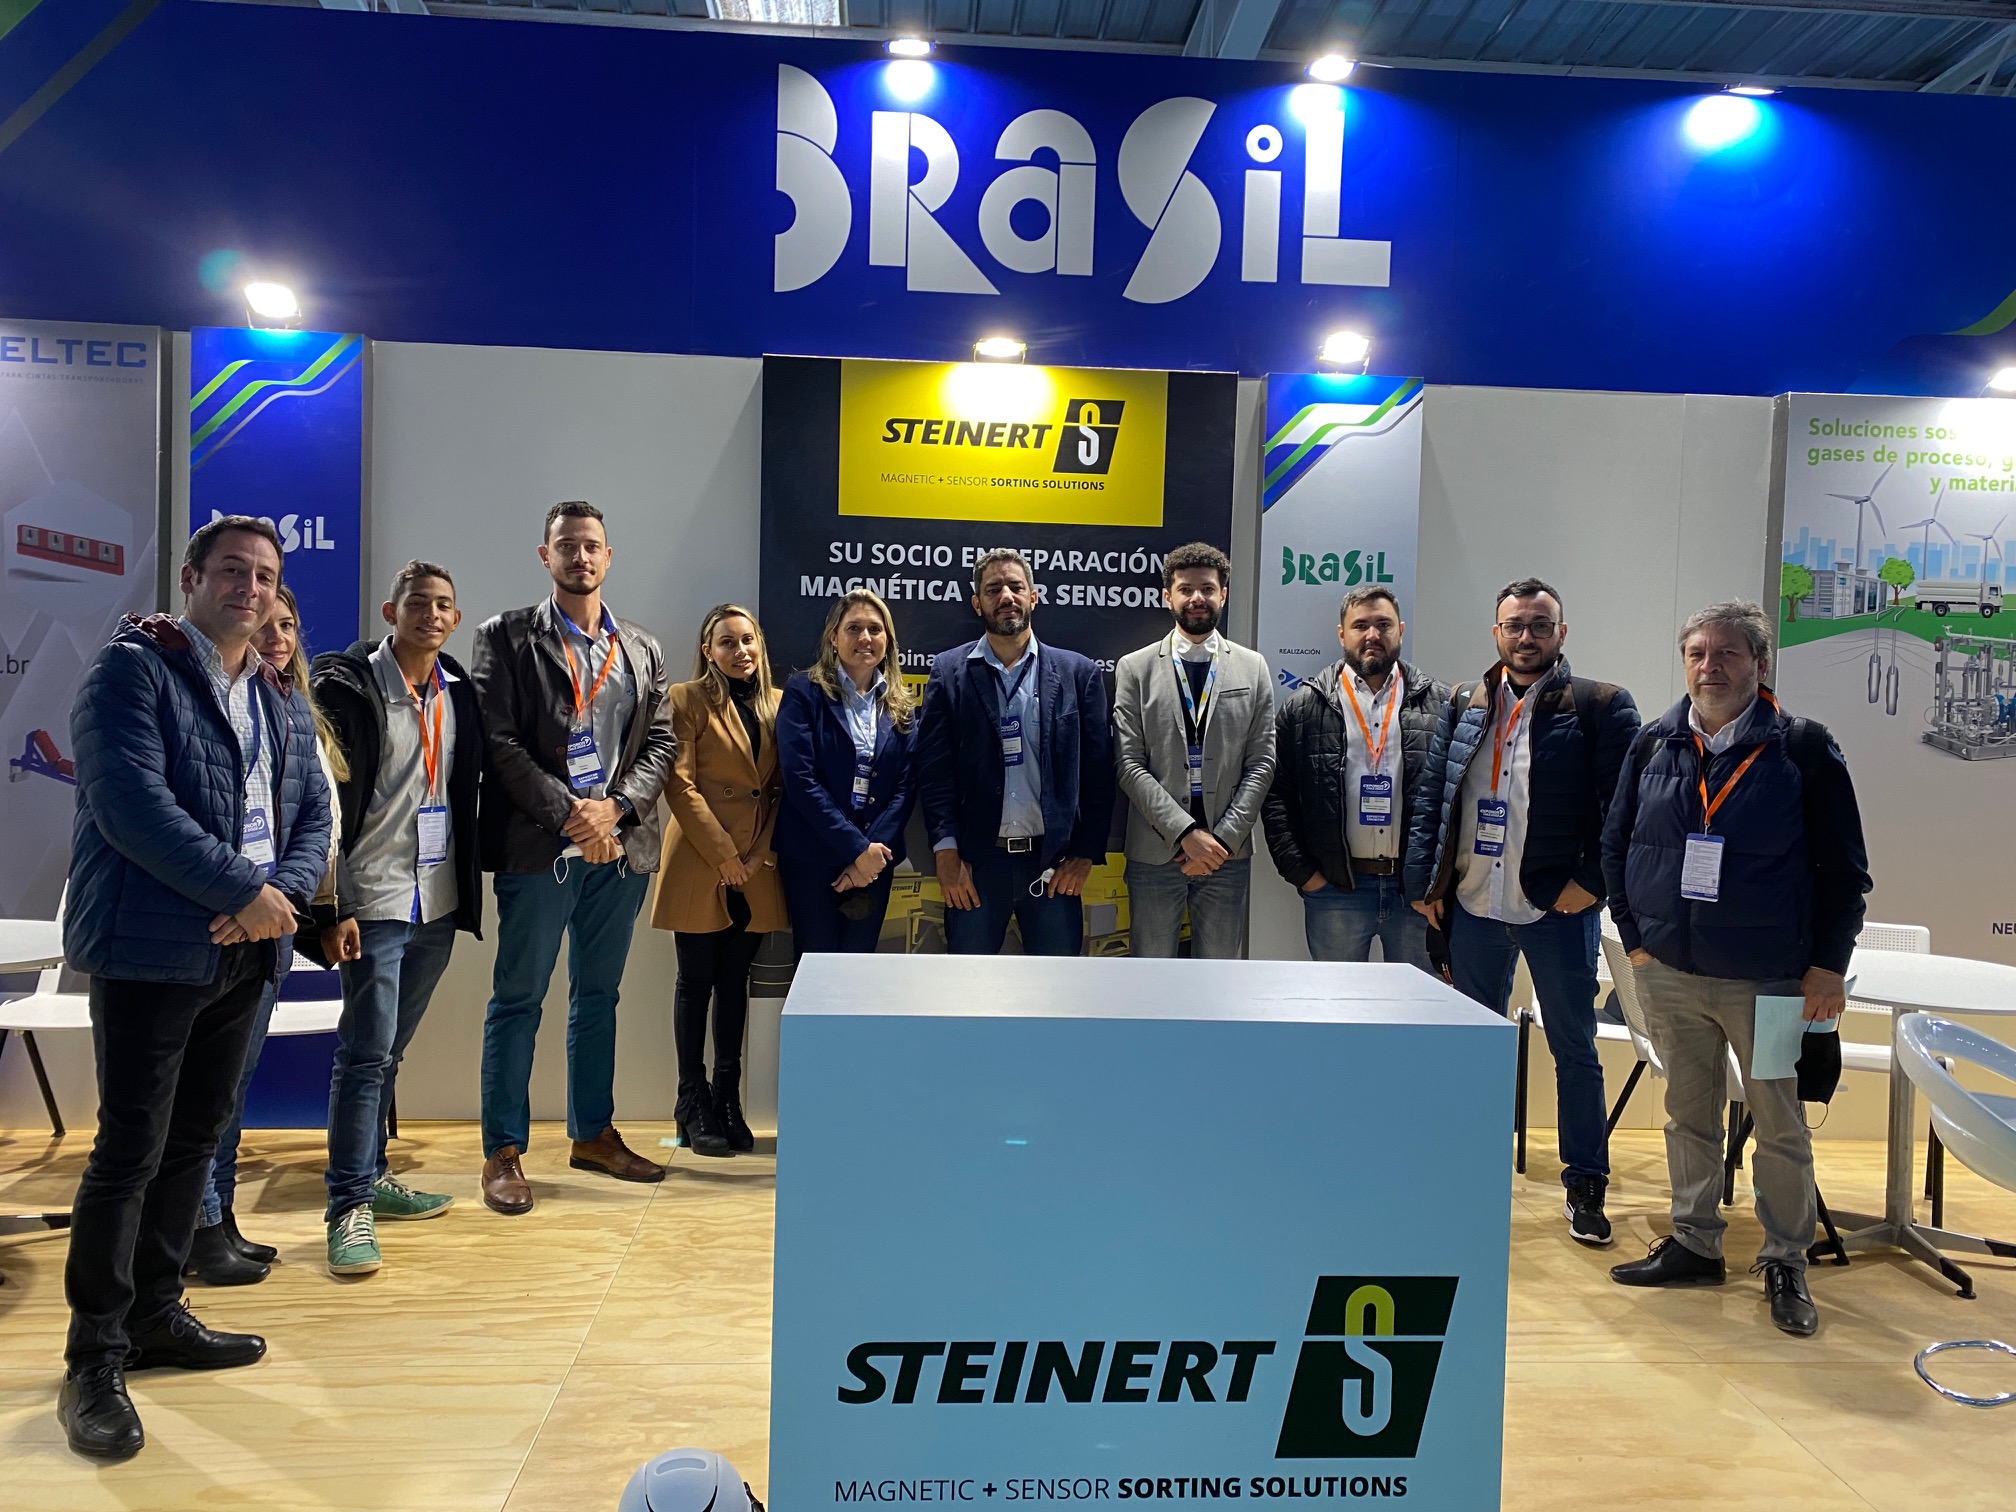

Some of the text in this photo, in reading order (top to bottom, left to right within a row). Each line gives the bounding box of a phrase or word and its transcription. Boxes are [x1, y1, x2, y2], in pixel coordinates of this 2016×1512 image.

[0, 336, 147, 368] ELTEC
[882, 417, 1053, 449] STEINERT
[1808, 417, 1958, 440] Soluciones sos
[1807, 446, 1866, 466] gases
[1872, 445, 1899, 463] de
[880, 472, 936, 484] MAGNETIC
[946, 475, 989, 487] SENSOR
[990, 478, 1040, 488] SORTING
[1042, 479, 1105, 491] SOLUTIONS
[1929, 474, 2016, 495] y materi
[829, 541, 863, 564] SU
[870, 543, 953, 567] SOCIO
[1006, 547, 1169, 574] EPARACIÓN
[800, 573, 963, 602] MAGNÉTICA
[1056, 585, 1169, 608] SENSOR
[1992, 922, 2016, 935] NE
[837, 1341, 1277, 1404] STEINERT
[835, 1480, 975, 1502] MAGNETIC
[1005, 1478, 1110, 1500] SENSOR
[1117, 1477, 1242, 1499] SORTING
[1249, 1476, 1408, 1498] SOLUTIONS
